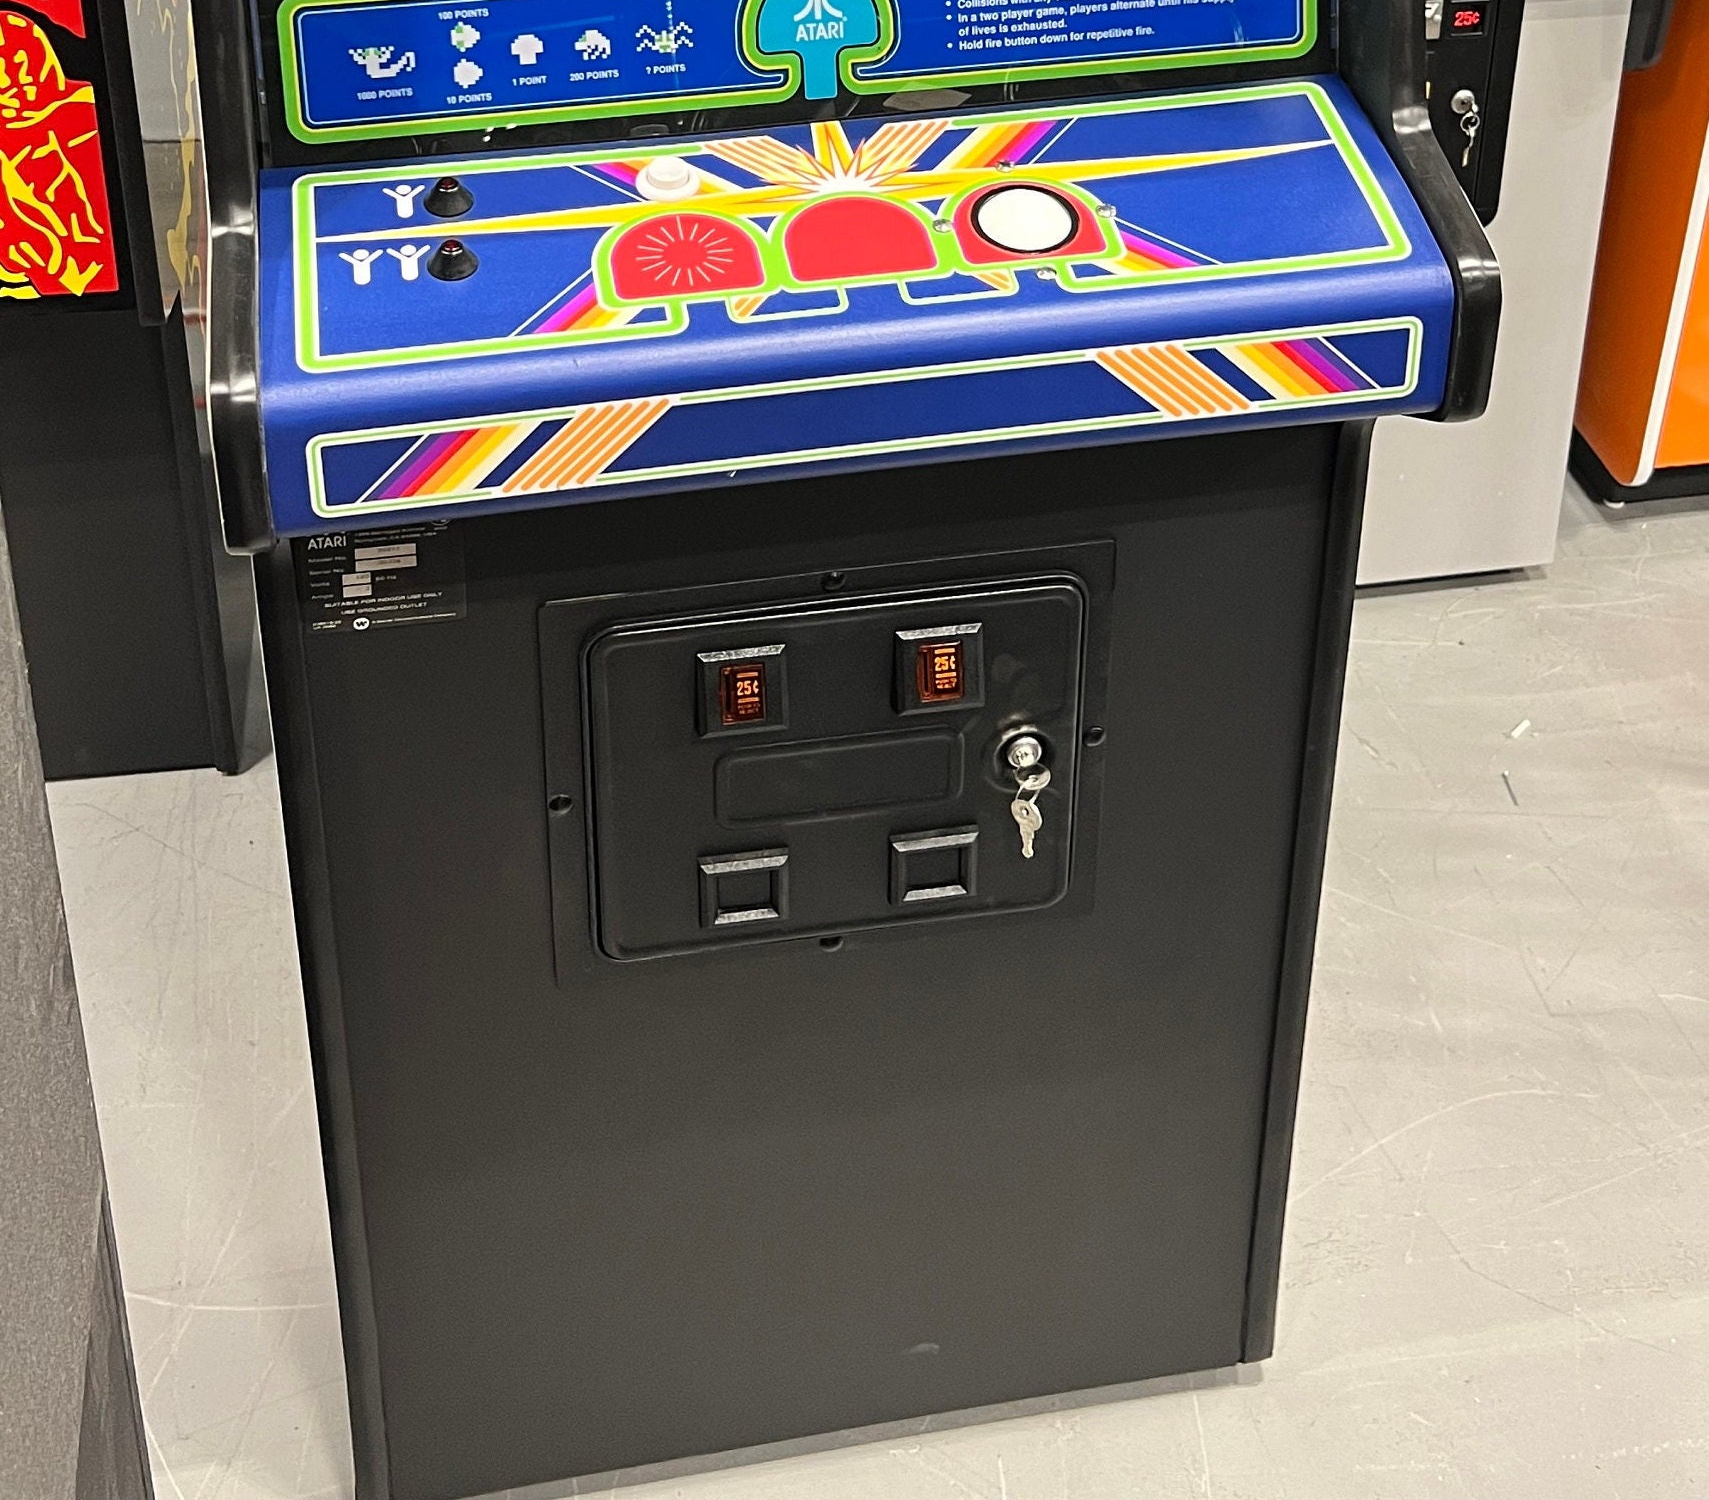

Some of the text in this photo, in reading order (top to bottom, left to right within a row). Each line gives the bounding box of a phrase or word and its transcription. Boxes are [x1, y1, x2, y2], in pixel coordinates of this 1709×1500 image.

[438, 8, 489, 20] 100 POINTS
[958, 13, 968, 23] In
[970, 14, 977, 22] a
[980, 11, 999, 21] two
[1001, 8, 1033, 21] player
[1036, 6, 1068, 18] game,
[1070, 2, 1108, 15] players
[1110, 0, 1156, 11] alternate
[1454, 10, 1480, 27] 25¢
[795, 20, 844, 42] ATARI
[958, 18, 1068, 37] of lives is exhausted.
[959, 25, 1155, 51] Hold fire button down for repetitive fire.
[569, 69, 620, 82] 200 POINTS
[653, 63, 687, 74] POINTS
[519, 75, 547, 86] POINT
[378, 88, 413, 99] POINTS
[447, 92, 492, 105] 10 POINTS
[307, 536, 347, 550] ATARI
[934, 655, 956, 671] 25¢
[736, 679, 760, 696] 25¢
